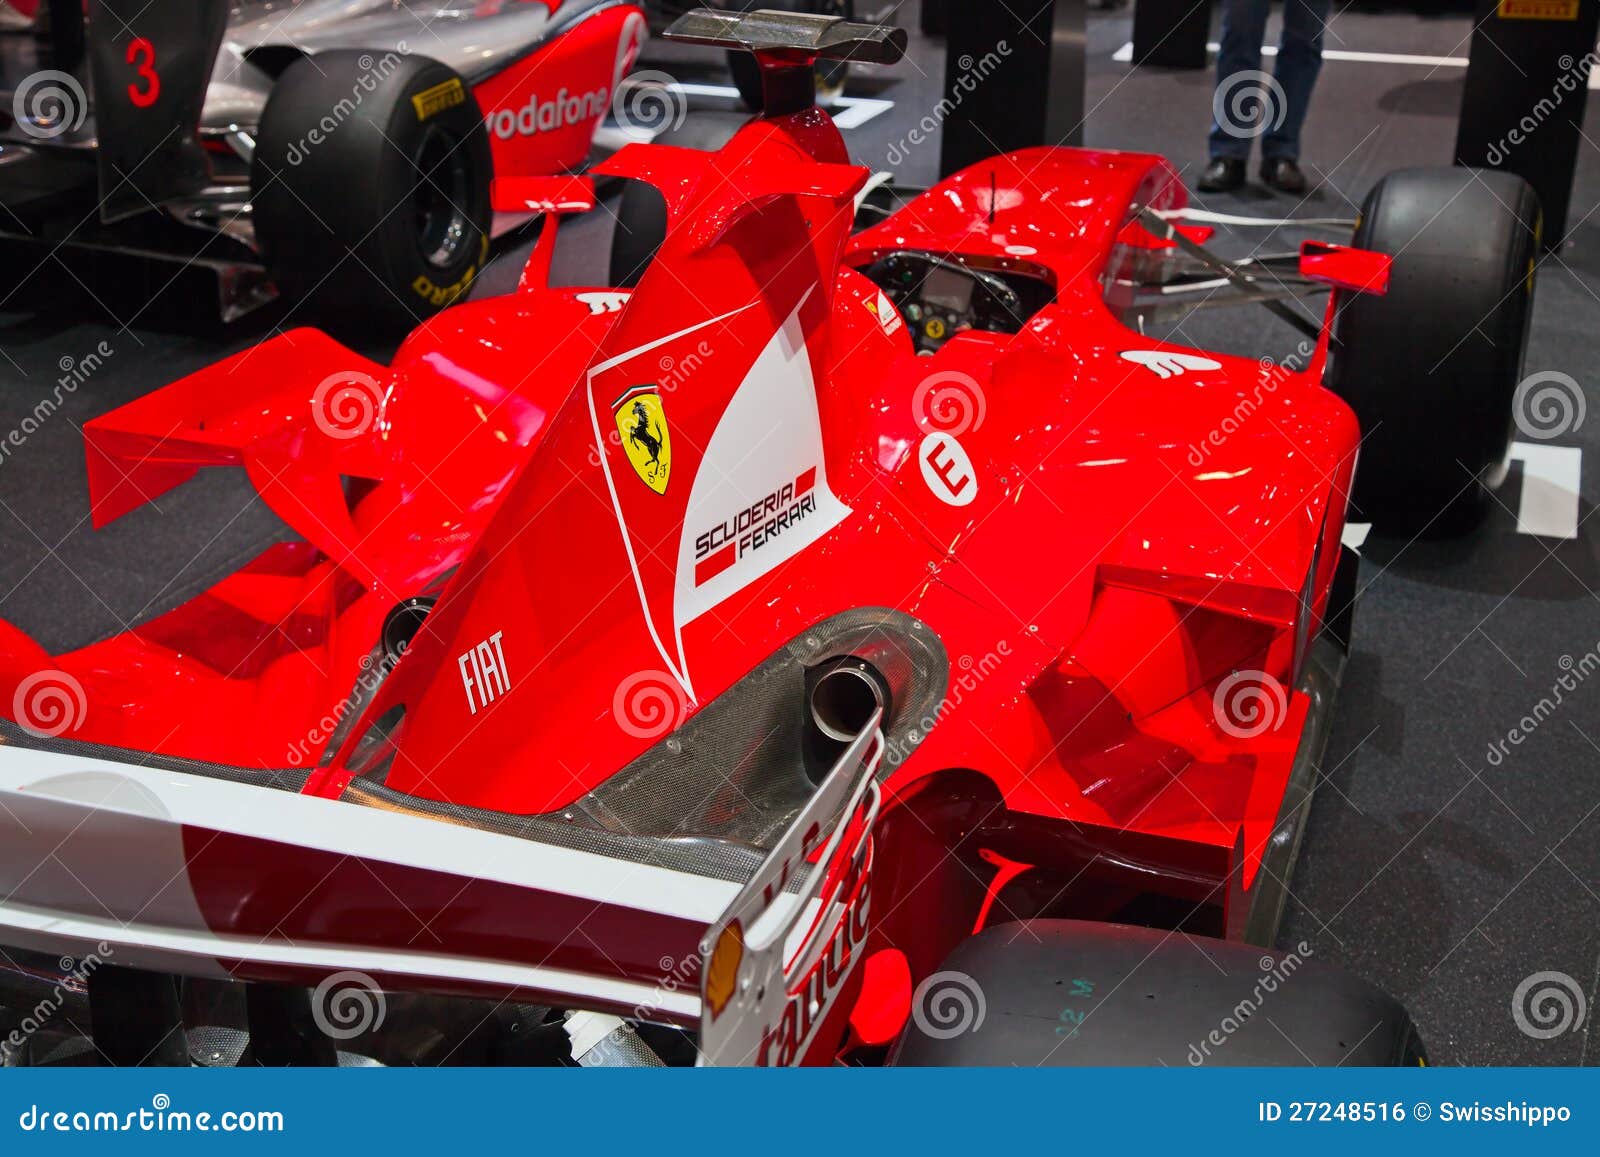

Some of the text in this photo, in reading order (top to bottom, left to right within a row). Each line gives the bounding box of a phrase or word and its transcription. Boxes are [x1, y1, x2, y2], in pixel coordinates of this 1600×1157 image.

[126, 37, 160, 108] 3
[926, 441, 970, 497] E
[695, 482, 793, 560] SCUDERIA
[739, 491, 817, 559] FERRARI
[458, 630, 511, 715] FIAT
